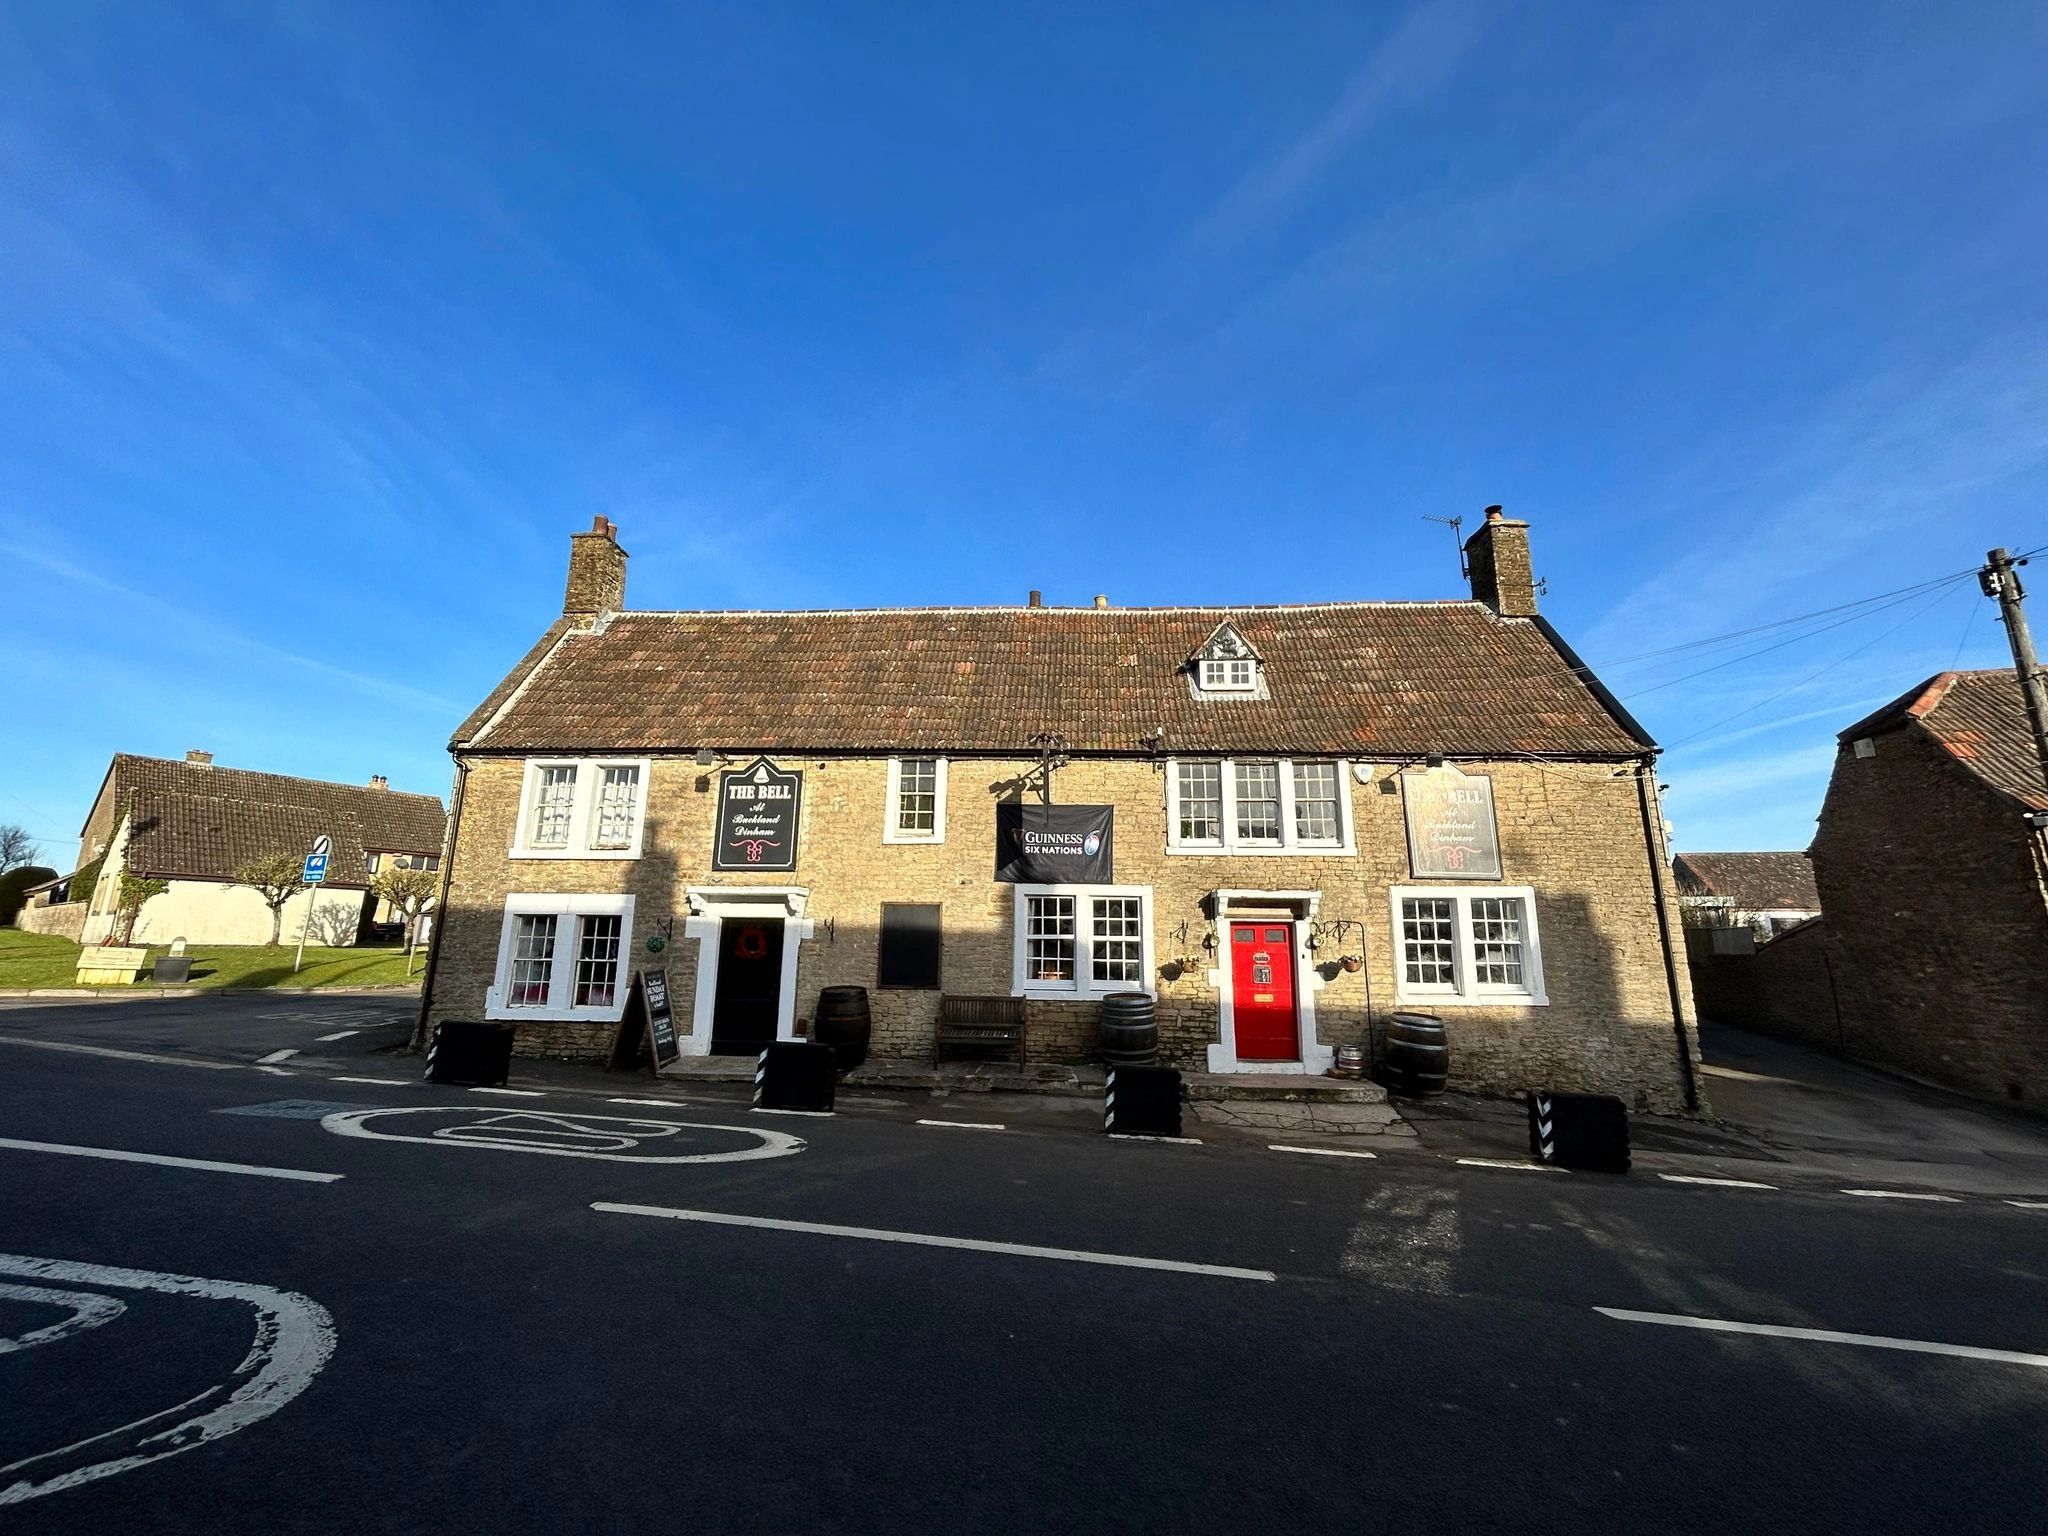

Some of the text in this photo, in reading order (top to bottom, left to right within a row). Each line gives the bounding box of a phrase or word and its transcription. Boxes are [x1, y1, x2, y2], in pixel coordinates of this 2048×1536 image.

[729, 785, 792, 799] THE BELL
[749, 802, 766, 812] At
[732, 814, 781, 824] Buckland
[734, 826, 776, 836] Dinham
[1025, 831, 1083, 844] GUINNESS
[1024, 846, 1083, 855] SIX NATIONS
